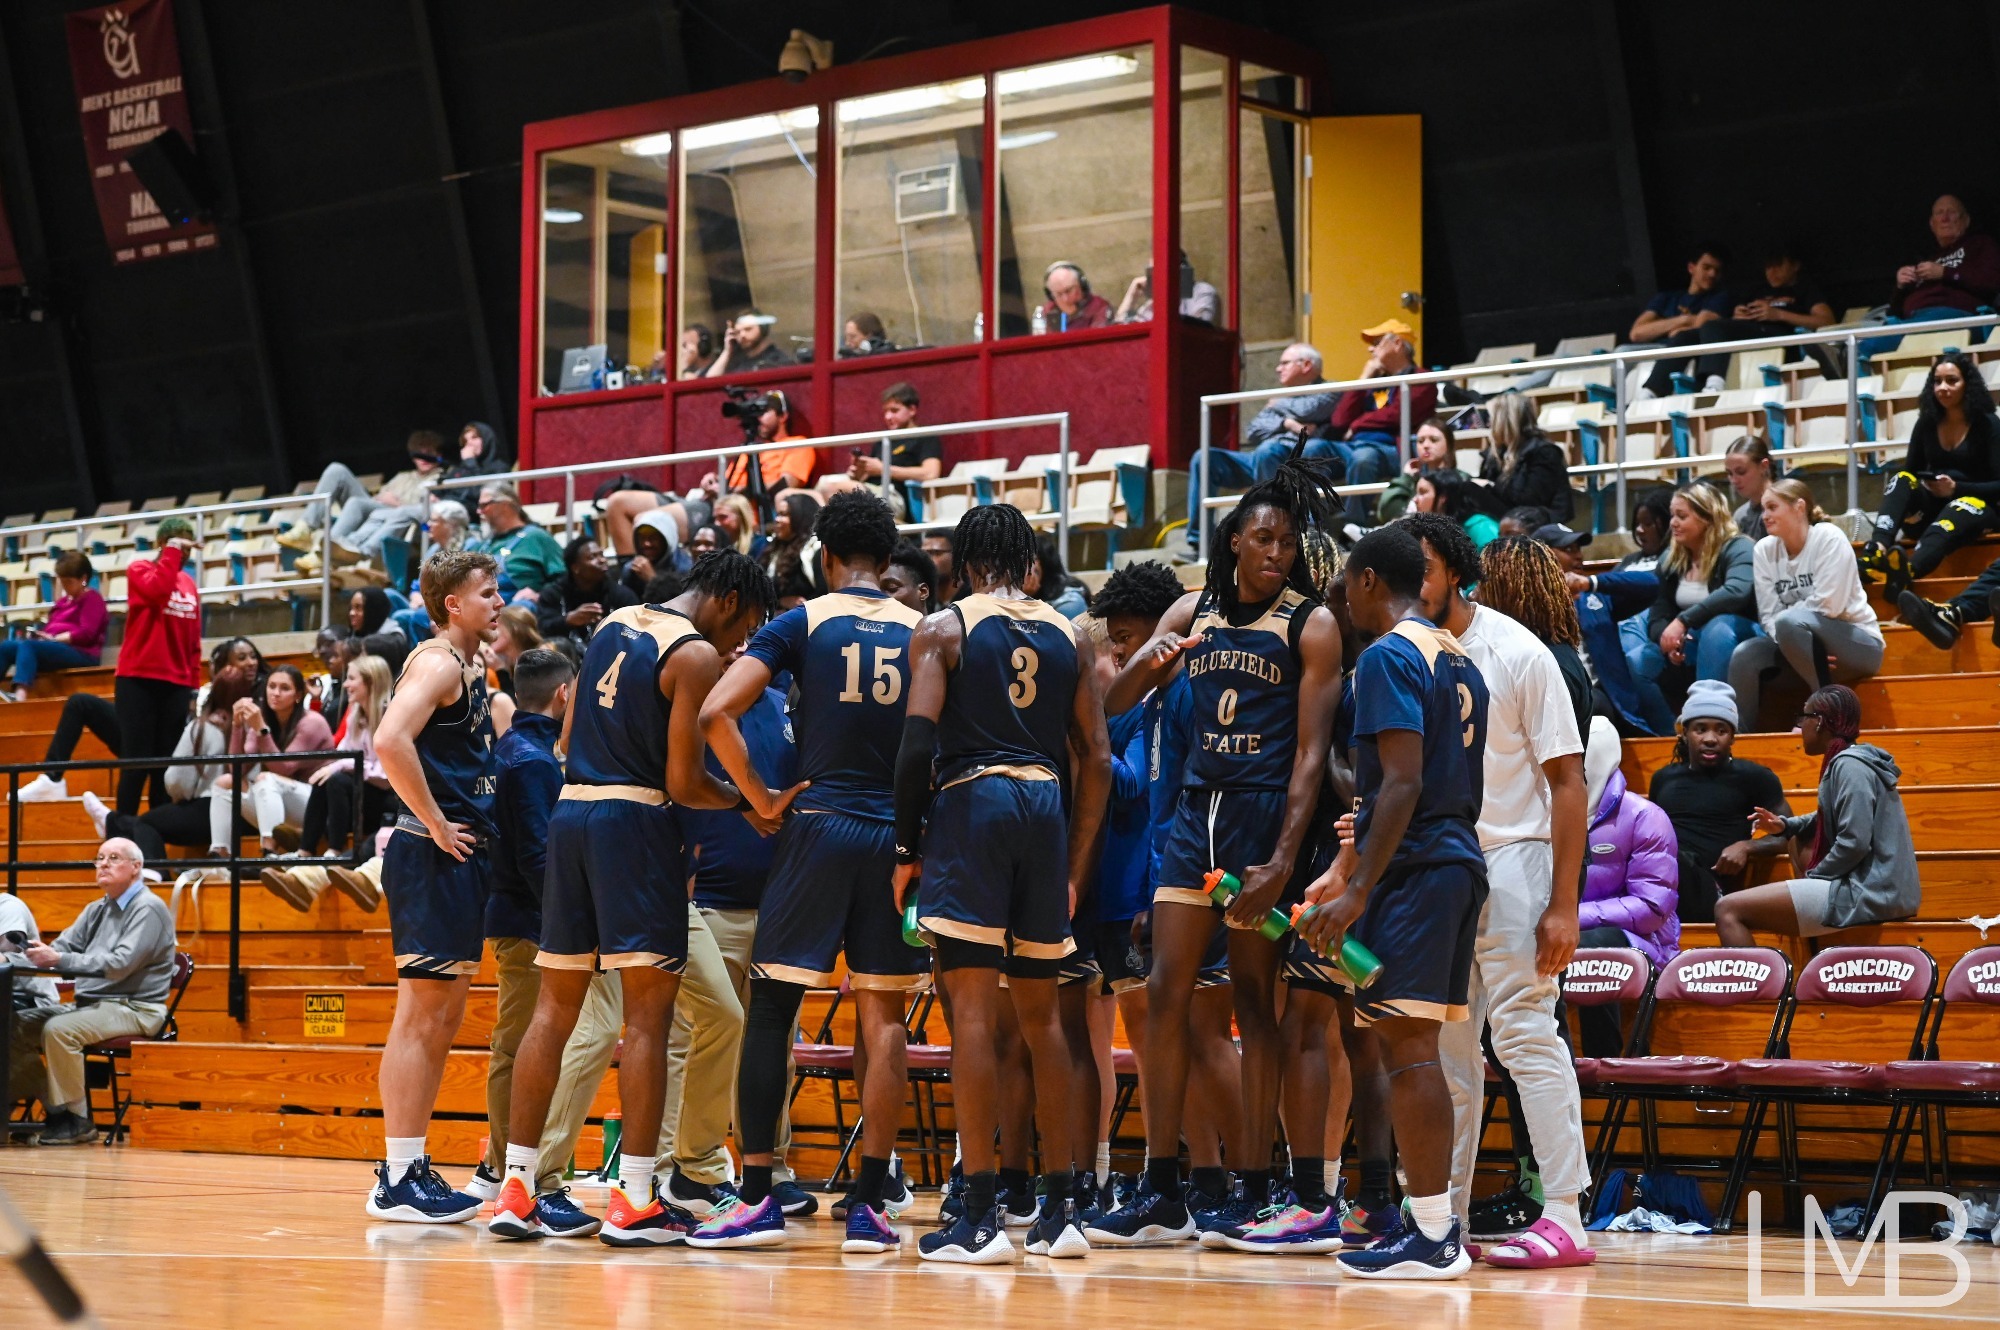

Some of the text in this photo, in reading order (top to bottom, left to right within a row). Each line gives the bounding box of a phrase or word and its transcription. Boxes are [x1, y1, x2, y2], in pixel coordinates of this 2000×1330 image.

[113, 76, 182, 106] BASKETBALL
[109, 100, 160, 134] NCAA
[596, 650, 627, 709] 4
[839, 642, 902, 705] 15
[1008, 646, 1039, 709] 3
[1189, 650, 1282, 685] BLUEFIELD
[1217, 688, 1238, 726] 0
[1202, 732, 1261, 754] STATE
[1678, 959, 1771, 983] CONCORD
[1818, 958, 1915, 983] CONCORD
[1562, 980, 1621, 993] ASKETBALL
[1686, 981, 1758, 993] BASKETBALL
[1827, 981, 1902, 994] BASKETBALL
[306, 996, 343, 1011] CAUTION
[305, 1014, 344, 1023] KEEP AISLE
[312, 1025, 336, 1034] CLEAR
